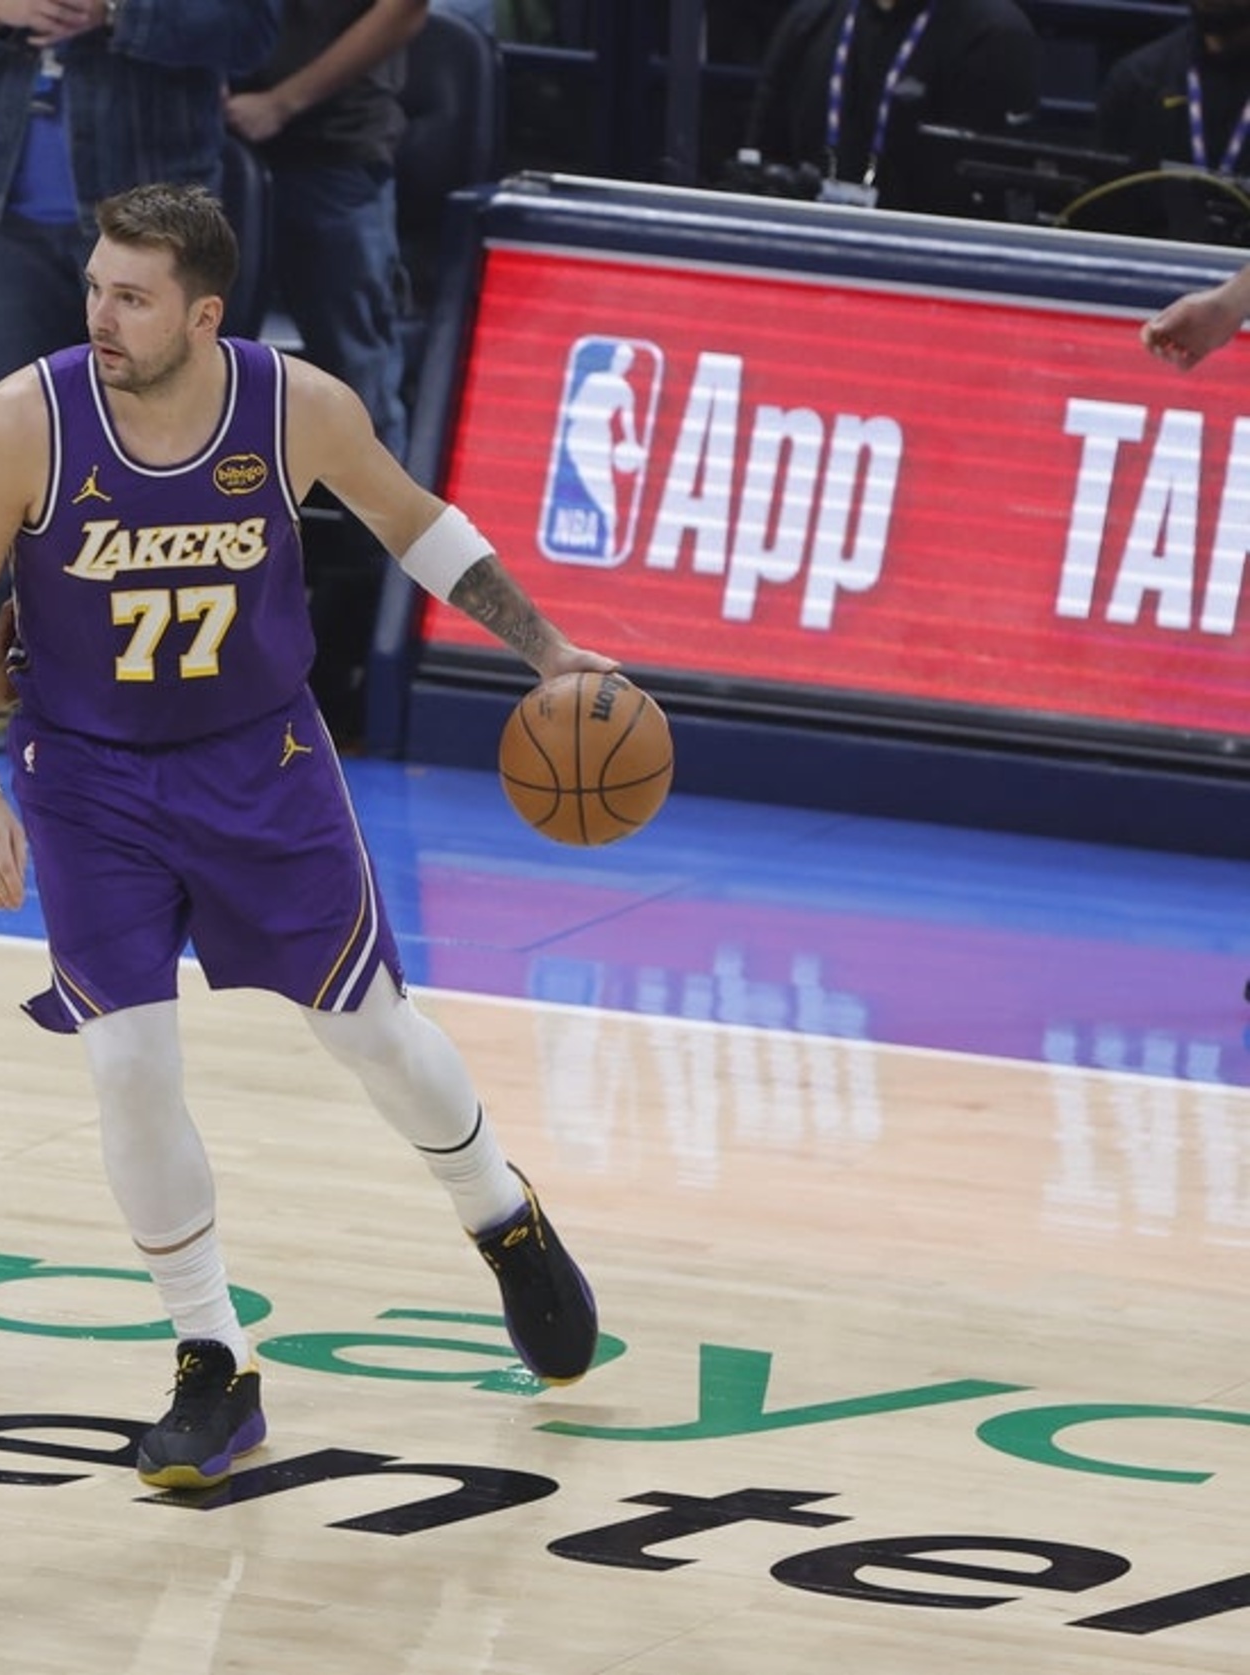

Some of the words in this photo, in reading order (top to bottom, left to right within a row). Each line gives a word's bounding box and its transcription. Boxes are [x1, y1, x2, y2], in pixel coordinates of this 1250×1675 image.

[551, 508, 598, 548] NBA
[645, 350, 903, 630] App
[63, 517, 268, 581] LAKERS
[110, 584, 237, 681] 77
